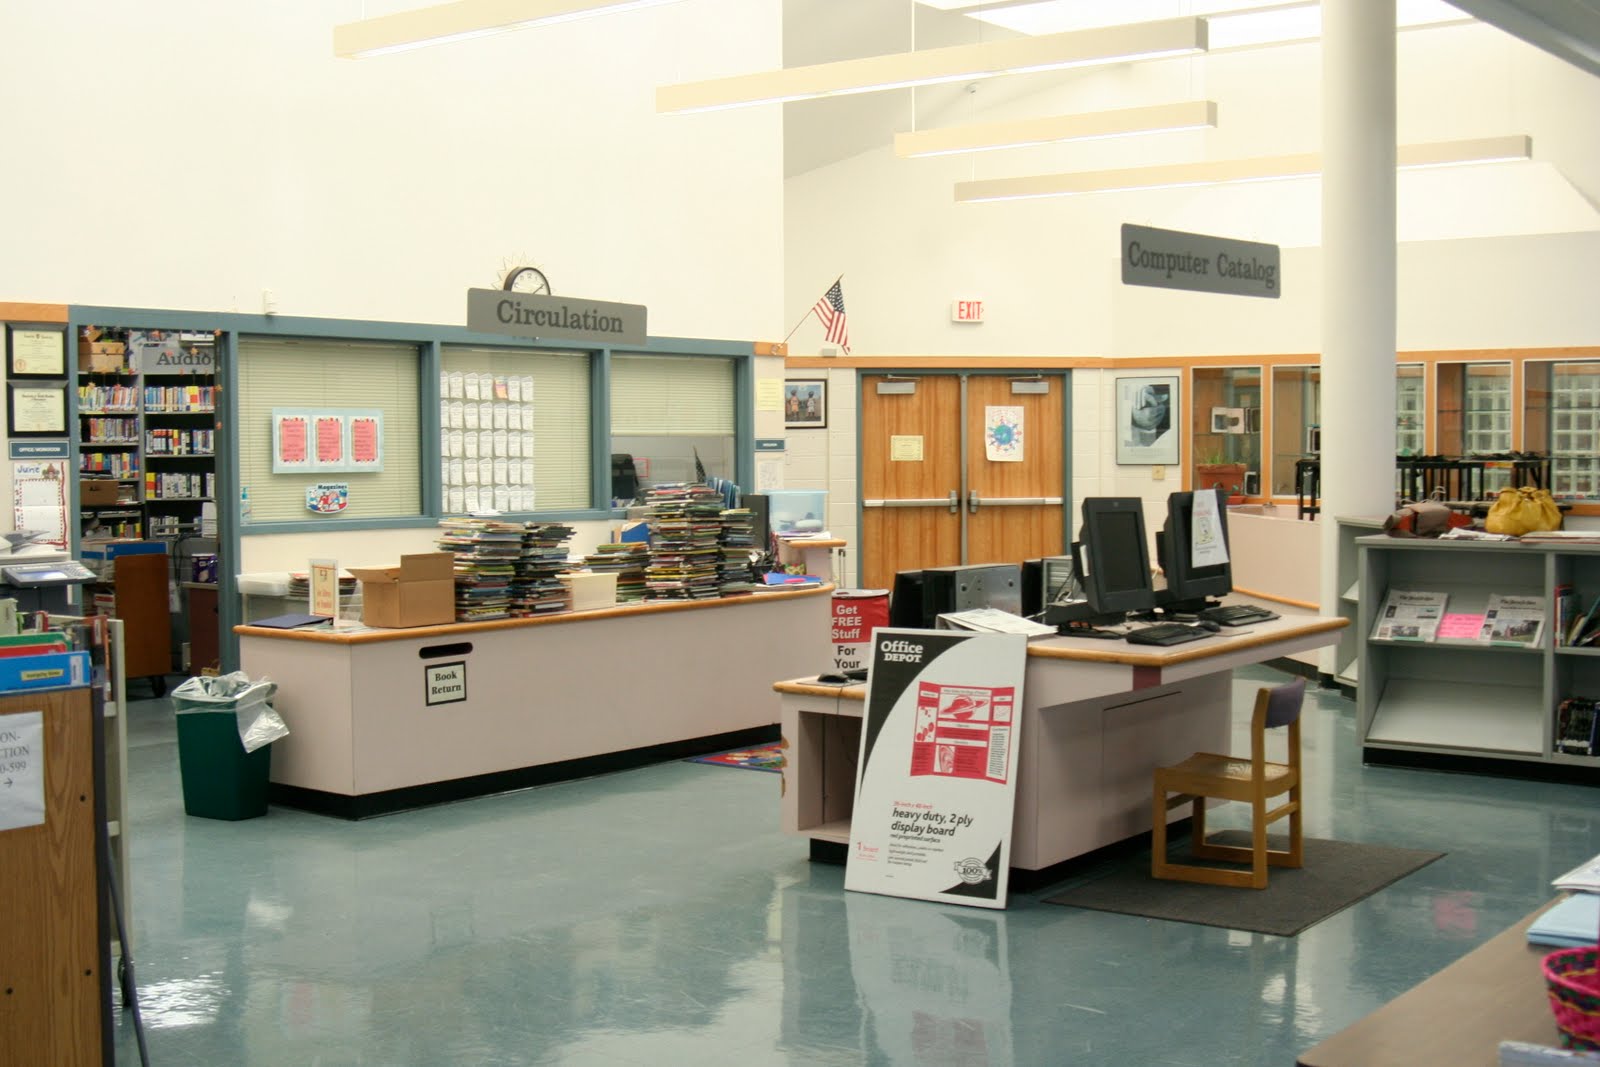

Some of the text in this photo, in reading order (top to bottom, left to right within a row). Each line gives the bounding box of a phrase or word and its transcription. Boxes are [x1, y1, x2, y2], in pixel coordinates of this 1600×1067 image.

[1128, 241, 1276, 290] Computer Catalog
[496, 299, 624, 333] Circulation
[958, 301, 983, 320] EXIT
[156, 351, 212, 366] Audio
[17, 465, 41, 474] June
[836, 604, 859, 615] Get
[832, 616, 862, 627] FREE
[831, 628, 860, 640] Stuff
[837, 645, 856, 656] For
[880, 640, 924, 654] Office
[833, 658, 861, 669] Your
[884, 653, 922, 663] DEPOT
[434, 670, 458, 682] Book
[431, 683, 462, 695] Return
[0, 745, 30, 759] TION
[892, 807, 974, 828] heavy duty, 2 ply
[891, 820, 956, 837] display board
